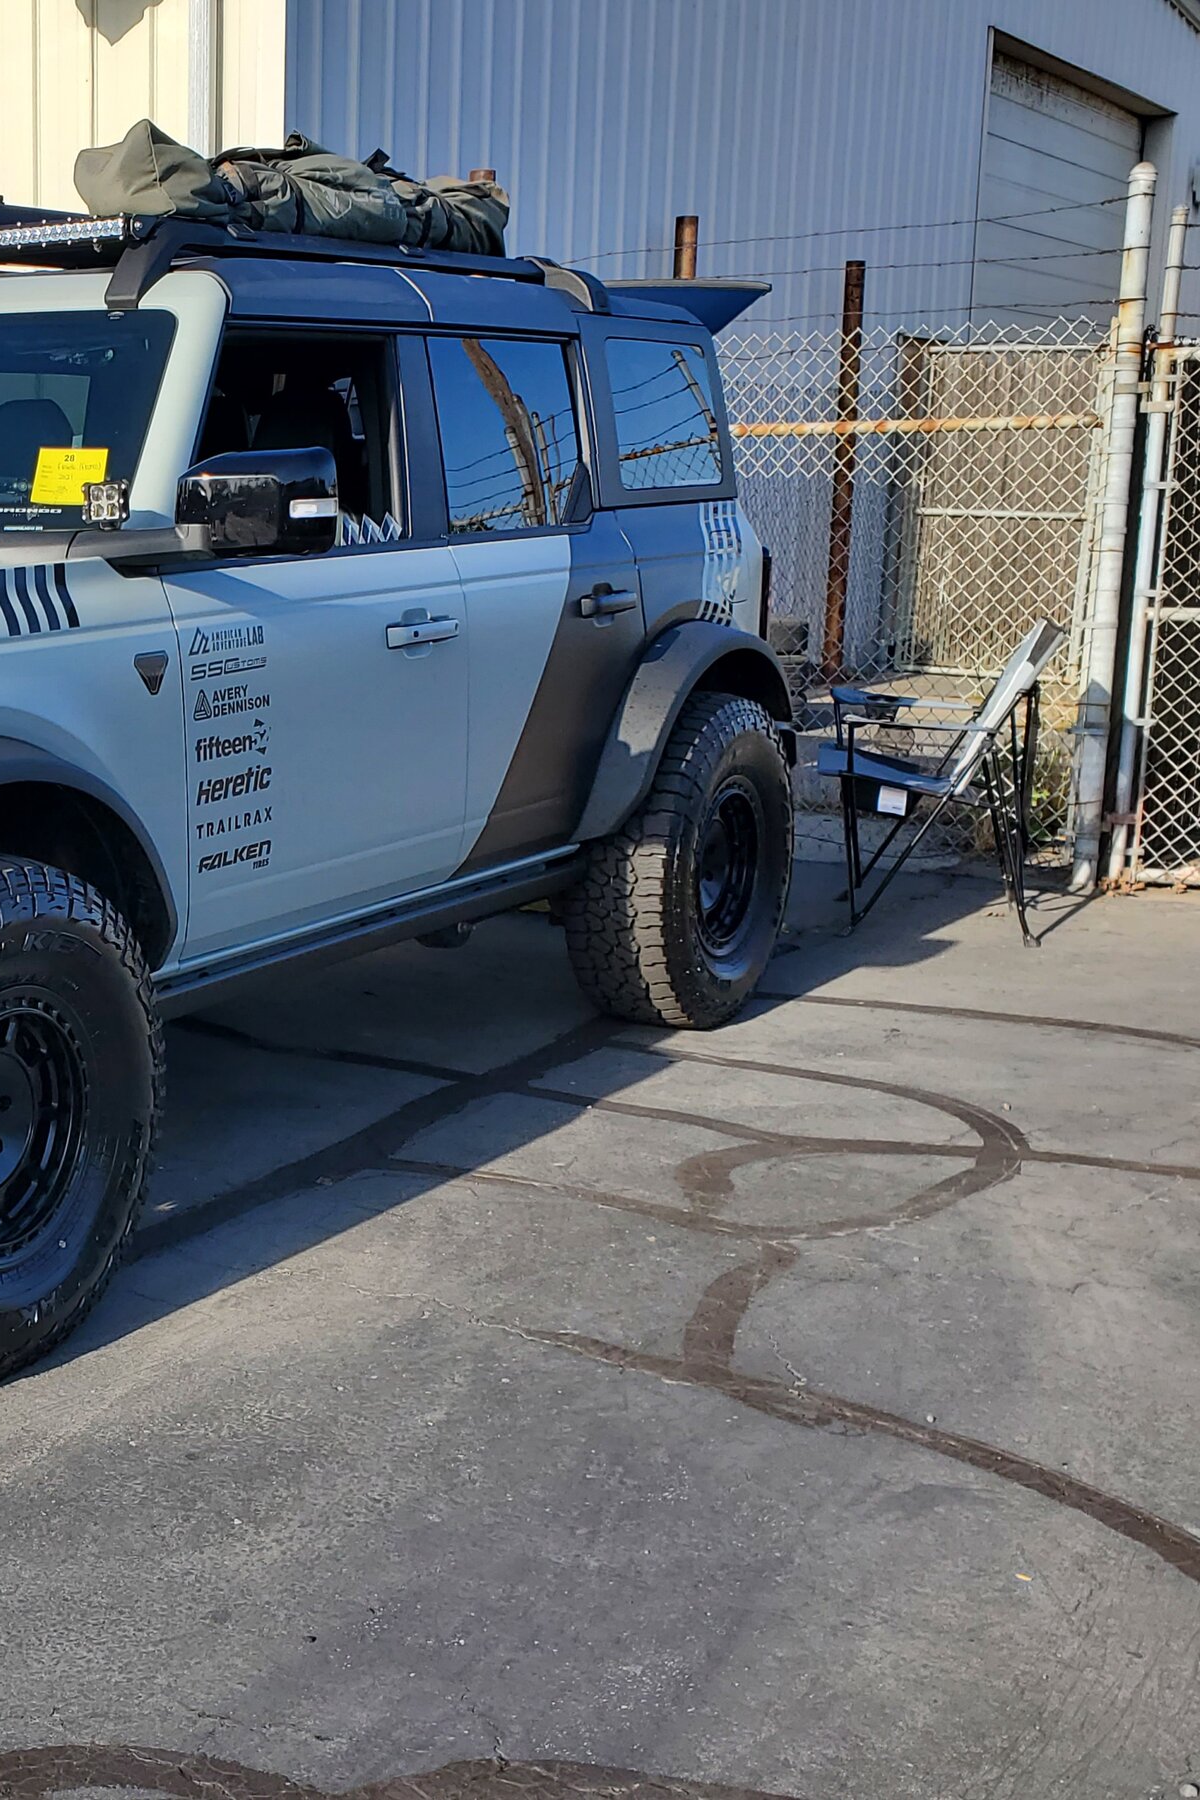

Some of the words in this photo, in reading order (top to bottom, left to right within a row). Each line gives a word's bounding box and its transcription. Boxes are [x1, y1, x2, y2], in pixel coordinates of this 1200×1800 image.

[211, 628, 242, 642] AMERICAN
[212, 637, 247, 651] ADVENTURE
[246, 625, 264, 646] LAB
[212, 684, 249, 704] AVERY
[212, 694, 270, 718] DENNISON
[195, 734, 253, 763] fifteen
[196, 764, 272, 806] Heretic
[196, 806, 272, 839] TRAILRAX
[198, 839, 272, 874] FALKEN
[252, 858, 269, 870] TIRES
